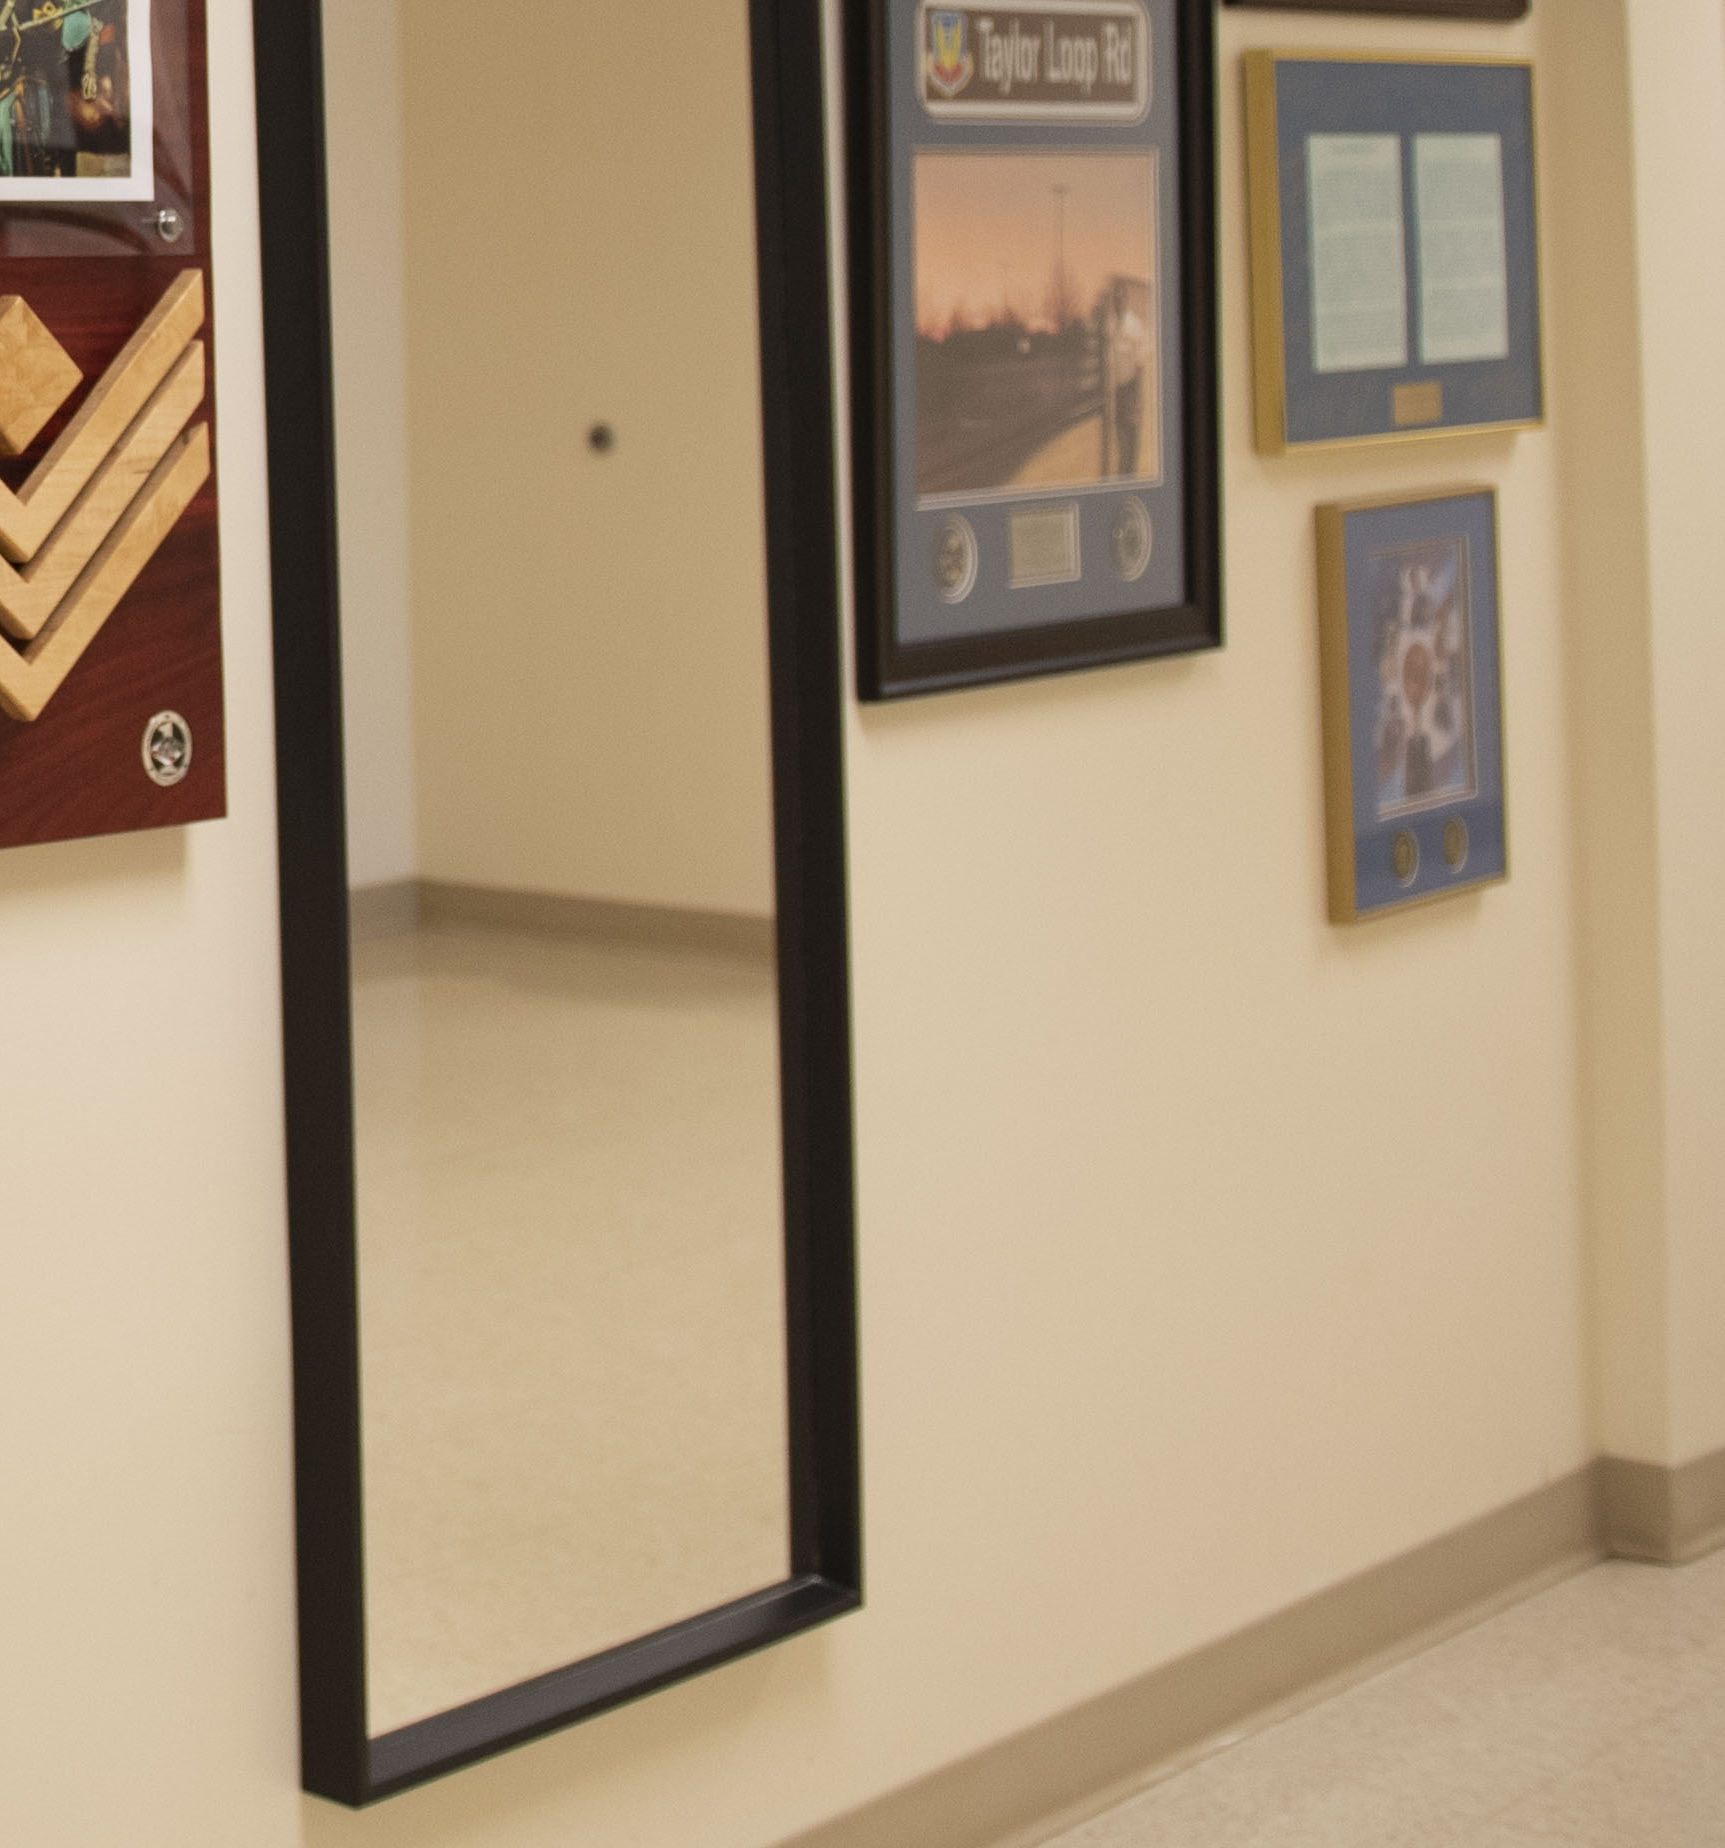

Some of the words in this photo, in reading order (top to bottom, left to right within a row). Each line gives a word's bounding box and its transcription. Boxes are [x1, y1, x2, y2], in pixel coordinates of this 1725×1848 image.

[975, 17, 1040, 94] Taylor
[1044, 22, 1098, 94] Loop
[1103, 21, 1133, 85] Rd
